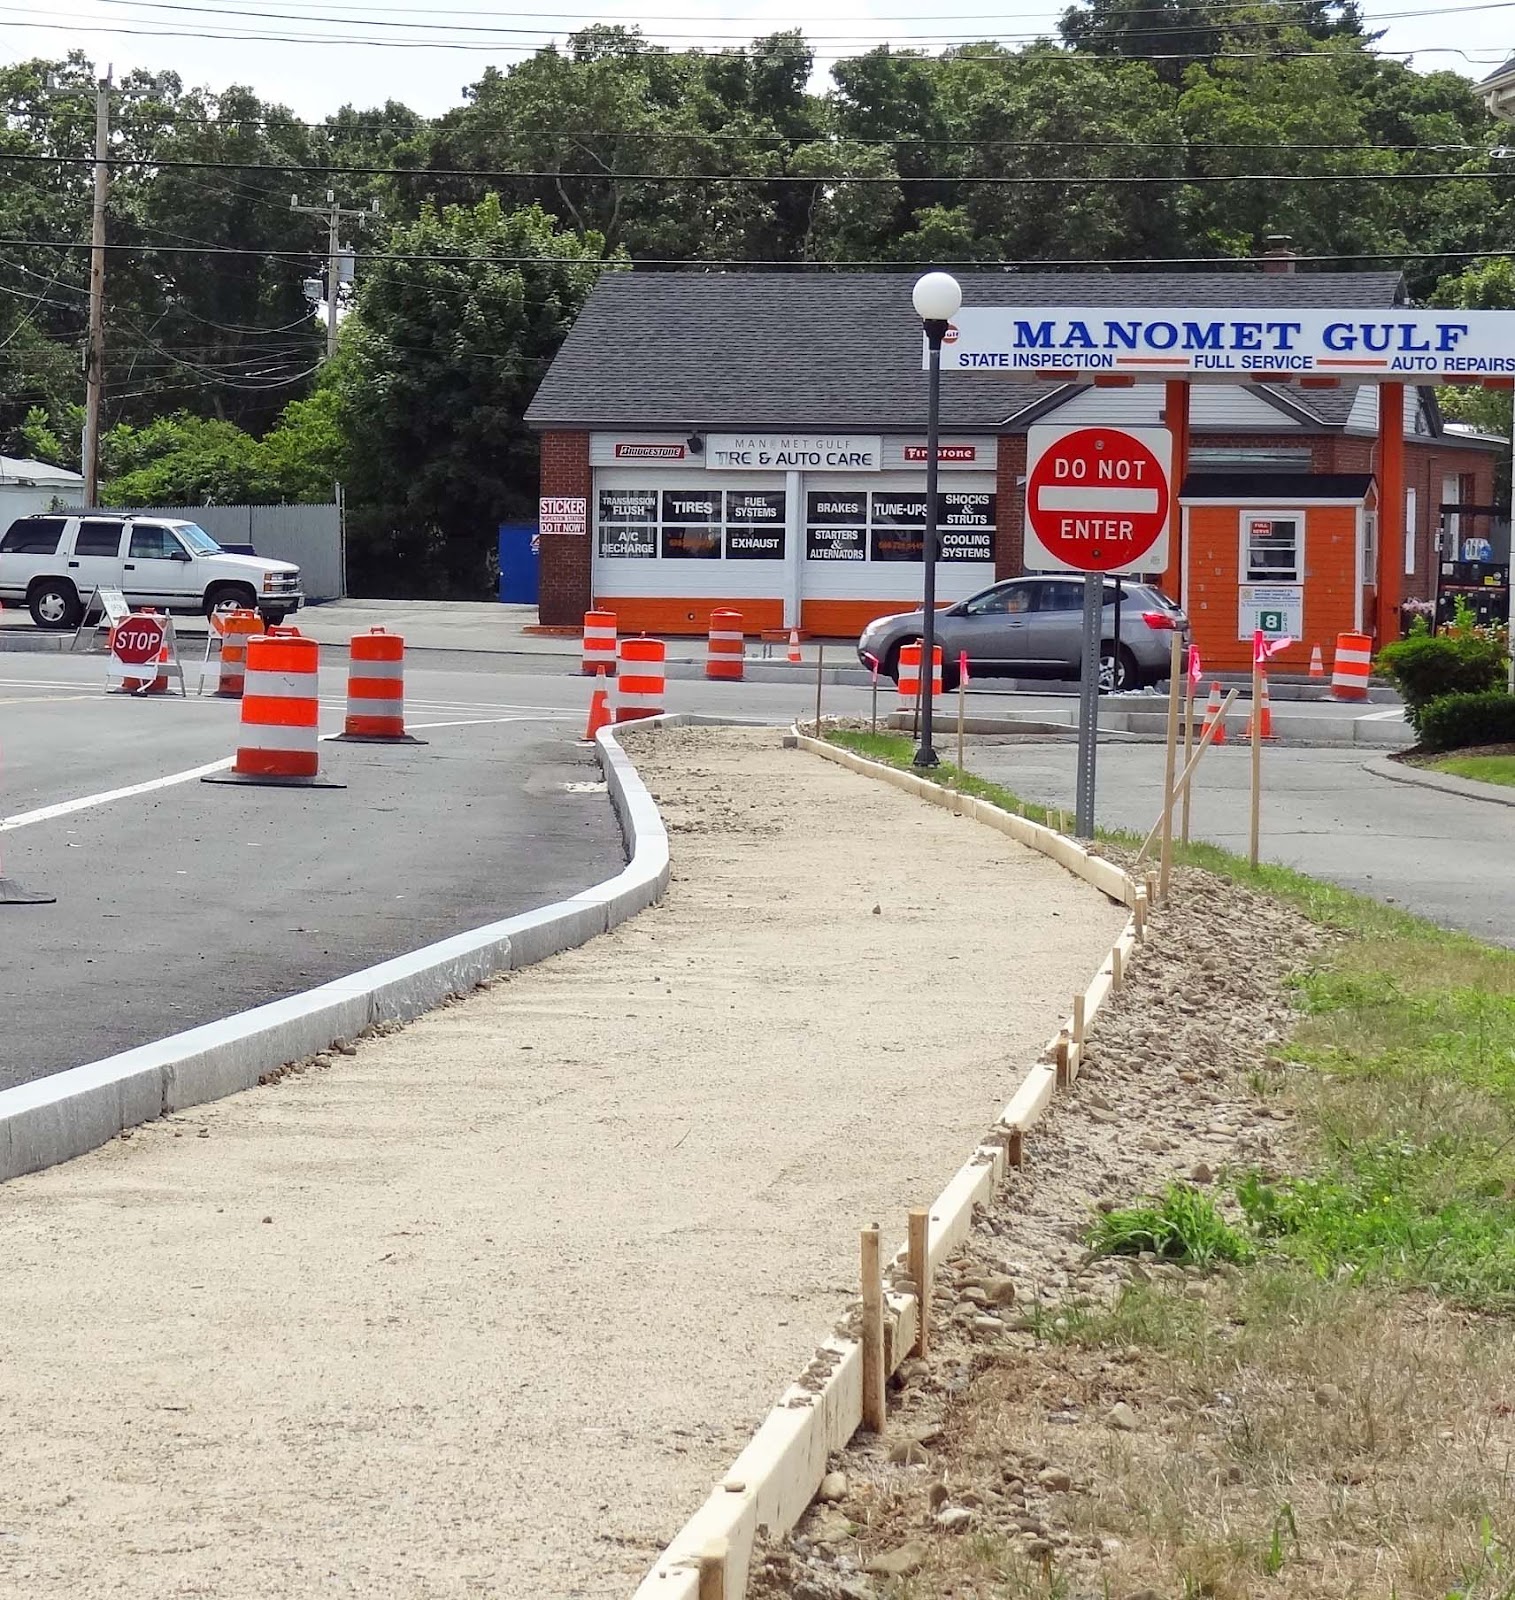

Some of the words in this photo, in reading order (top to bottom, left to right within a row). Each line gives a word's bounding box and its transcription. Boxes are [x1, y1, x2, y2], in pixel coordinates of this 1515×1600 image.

[1013, 321, 1301, 350] MANOMET
[1322, 323, 1468, 351] GULF
[959, 353, 1009, 367] STATE
[1013, 353, 1113, 368] INSPECTION
[1194, 355, 1235, 369] FULL
[1241, 355, 1313, 369] SERVICE
[1391, 356, 1438, 370] AUTO
[1443, 357, 1515, 371] REPAIRS
[735, 439, 810, 449] MANMET
[816, 439, 851, 449] GULF
[620, 446, 681, 456] BRIDGESTONE
[907, 447, 972, 459] Firstone
[759, 451, 772, 465] &
[775, 452, 820, 465] AUTO
[826, 452, 872, 466] CARE
[1054, 458, 1087, 479] DO
[1098, 459, 1146, 480] NOT
[602, 497, 656, 506] TRANSMISSION
[744, 497, 767, 507] FUEL
[945, 494, 990, 505] SHOCKS
[541, 500, 584, 514] STICKER
[613, 505, 645, 516] FLUSH
[673, 501, 713, 514] TIRES
[735, 507, 777, 517] SYSTEMS
[817, 503, 859, 513] BRAKES
[874, 503, 928, 517] TUNE-UPS
[961, 504, 975, 515] &
[946, 514, 988, 525] STRUTS
[541, 523, 553, 532] DO
[554, 523, 561, 532] IT
[563, 523, 584, 532] NOW!
[1061, 519, 1134, 540] ENTER
[618, 531, 639, 542] A/C
[815, 530, 858, 540] STARTERS
[943, 535, 990, 545] COOLING
[601, 543, 655, 553] RECHARGE
[731, 538, 780, 549] EXHAUST
[830, 540, 844, 550] &
[810, 549, 864, 560] ALTERNATORS
[942, 548, 991, 558] SYSTEMS
[1265, 615, 1278, 629] 8
[116, 631, 160, 651] STOP
